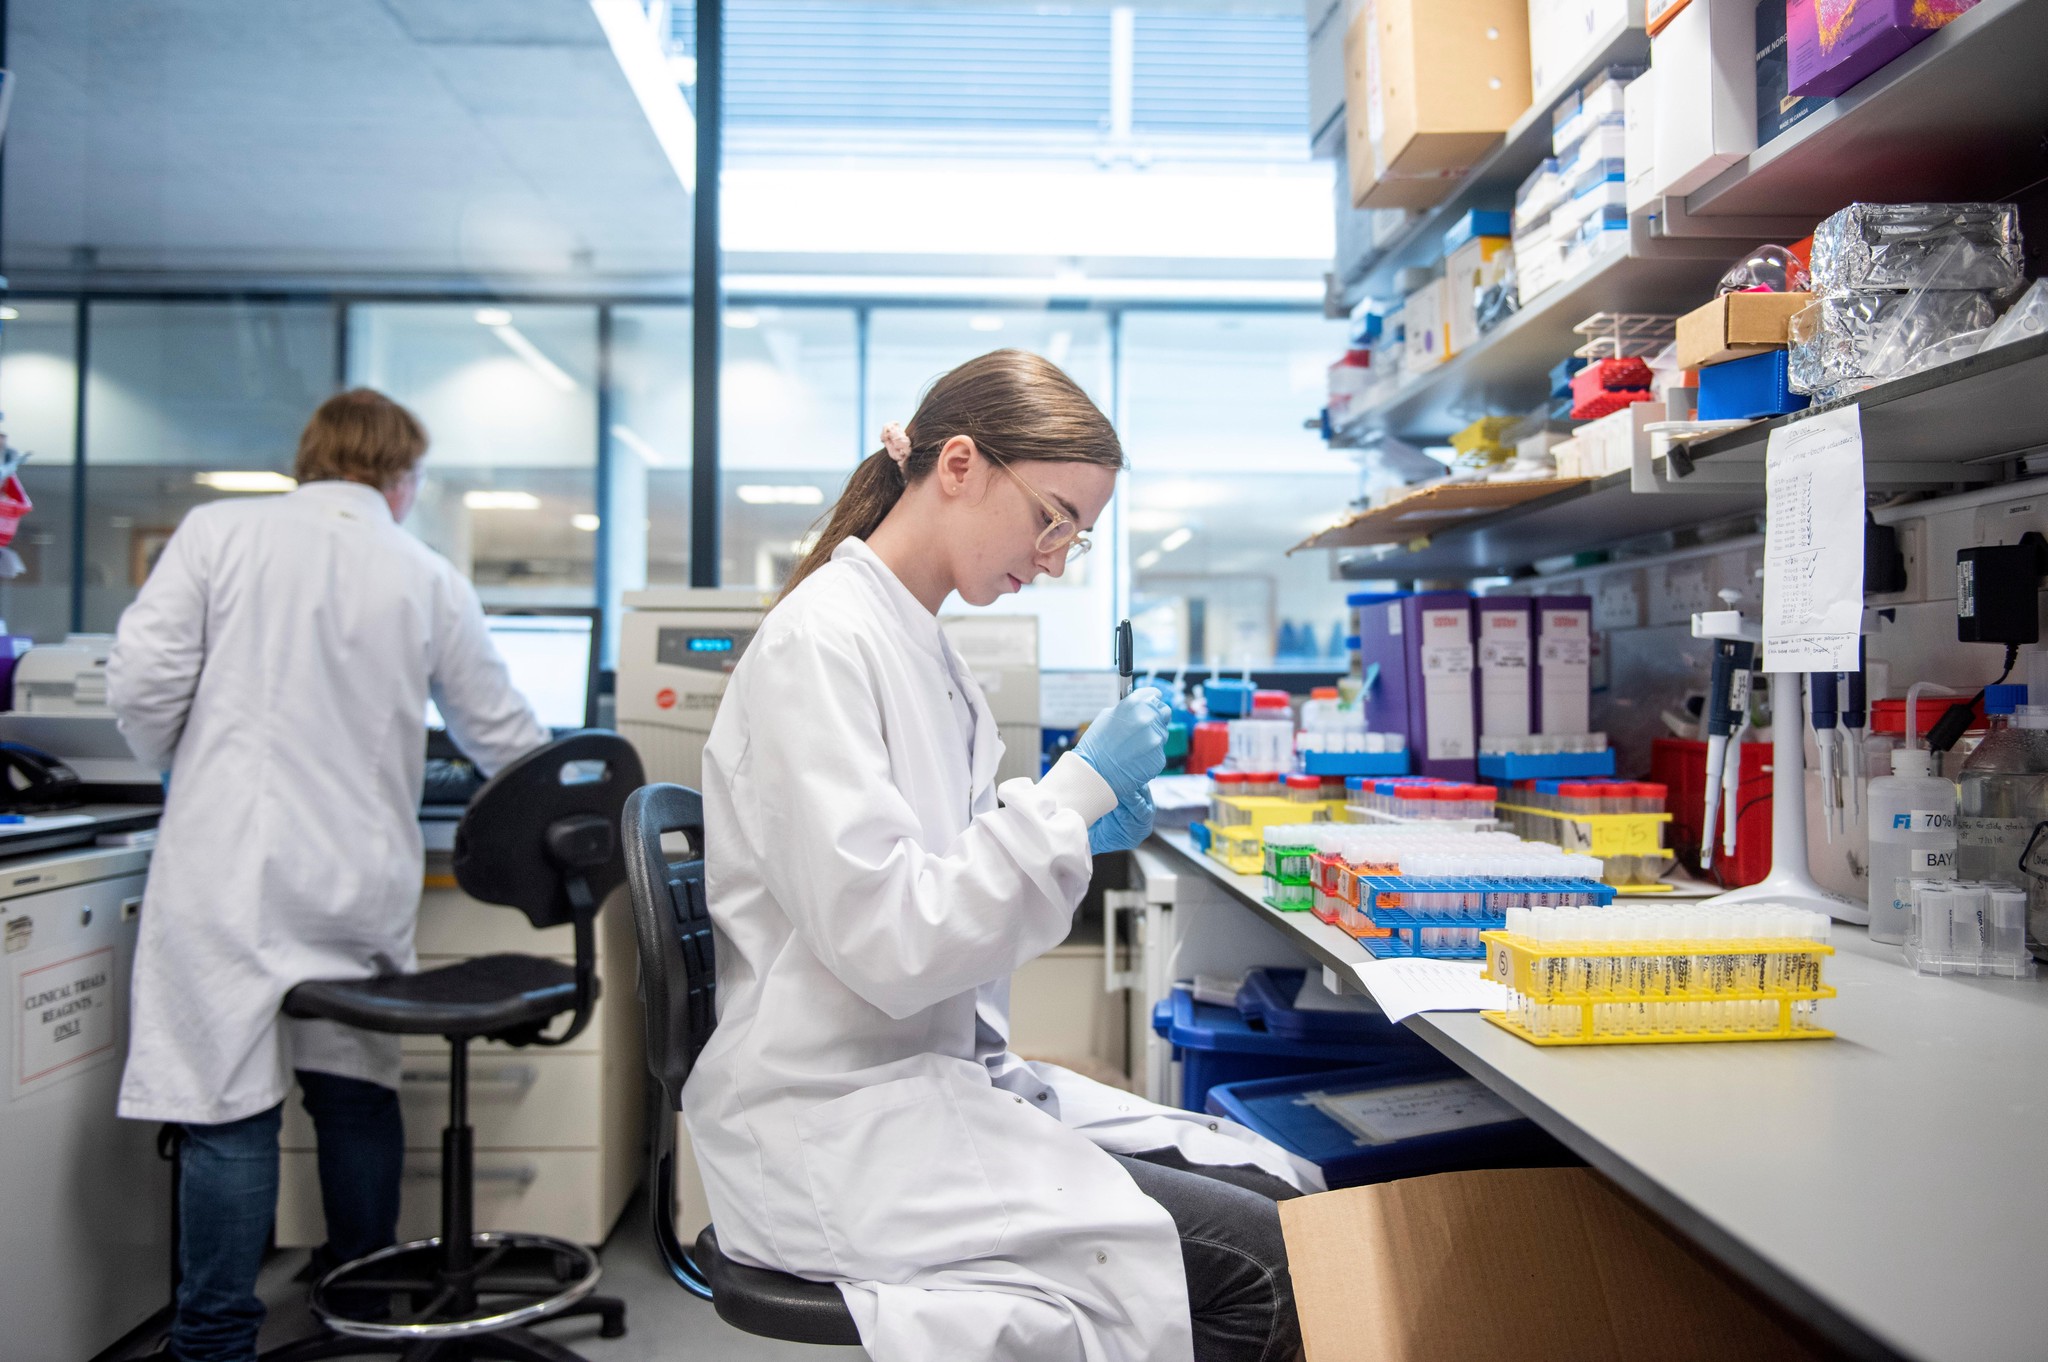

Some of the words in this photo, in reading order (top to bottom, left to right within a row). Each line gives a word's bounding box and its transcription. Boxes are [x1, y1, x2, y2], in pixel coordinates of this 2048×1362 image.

[1925, 814, 1952, 828] 70%
[25, 986, 71, 1010] CLINICAL
[74, 973, 106, 992] TRIALS
[41, 996, 93, 1025] REAGENTS
[54, 1018, 81, 1039] ONLY
